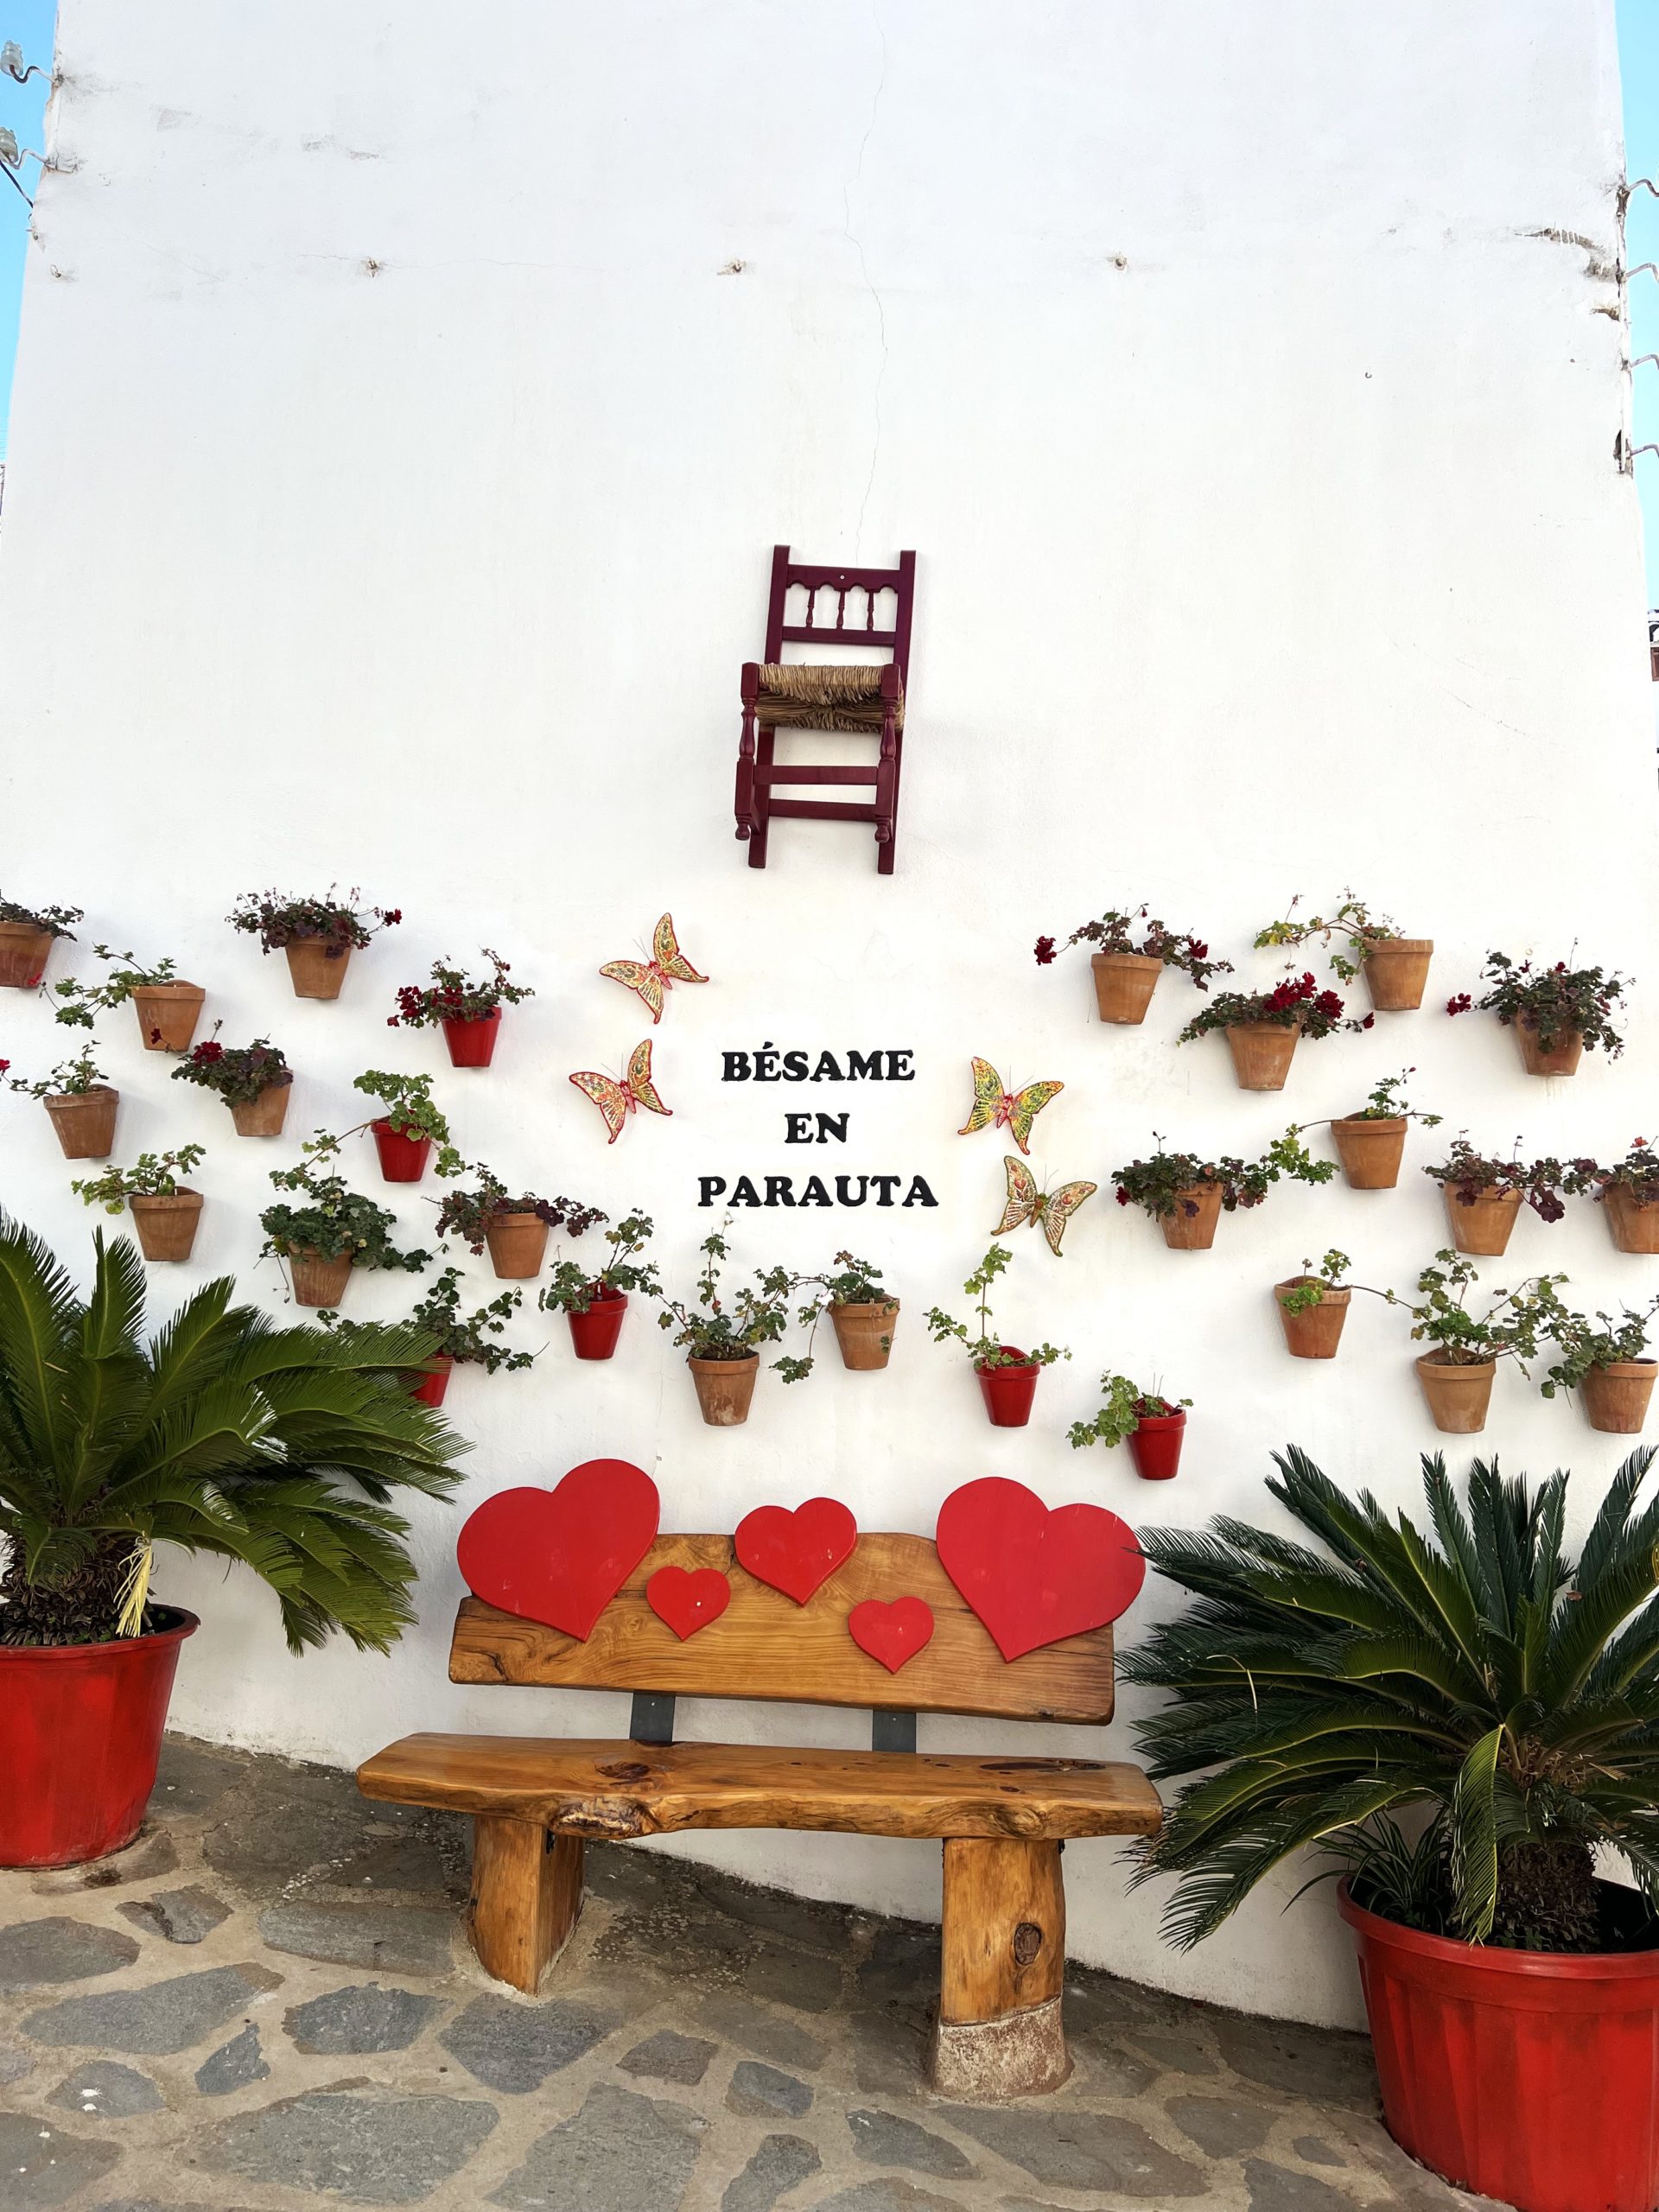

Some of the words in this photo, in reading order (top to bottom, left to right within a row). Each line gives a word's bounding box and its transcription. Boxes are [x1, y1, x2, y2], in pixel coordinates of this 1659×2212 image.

[721, 1041, 916, 1083] BÉSAME
[784, 1112, 850, 1144] EN
[697, 1174, 939, 1208] PARAUTA
